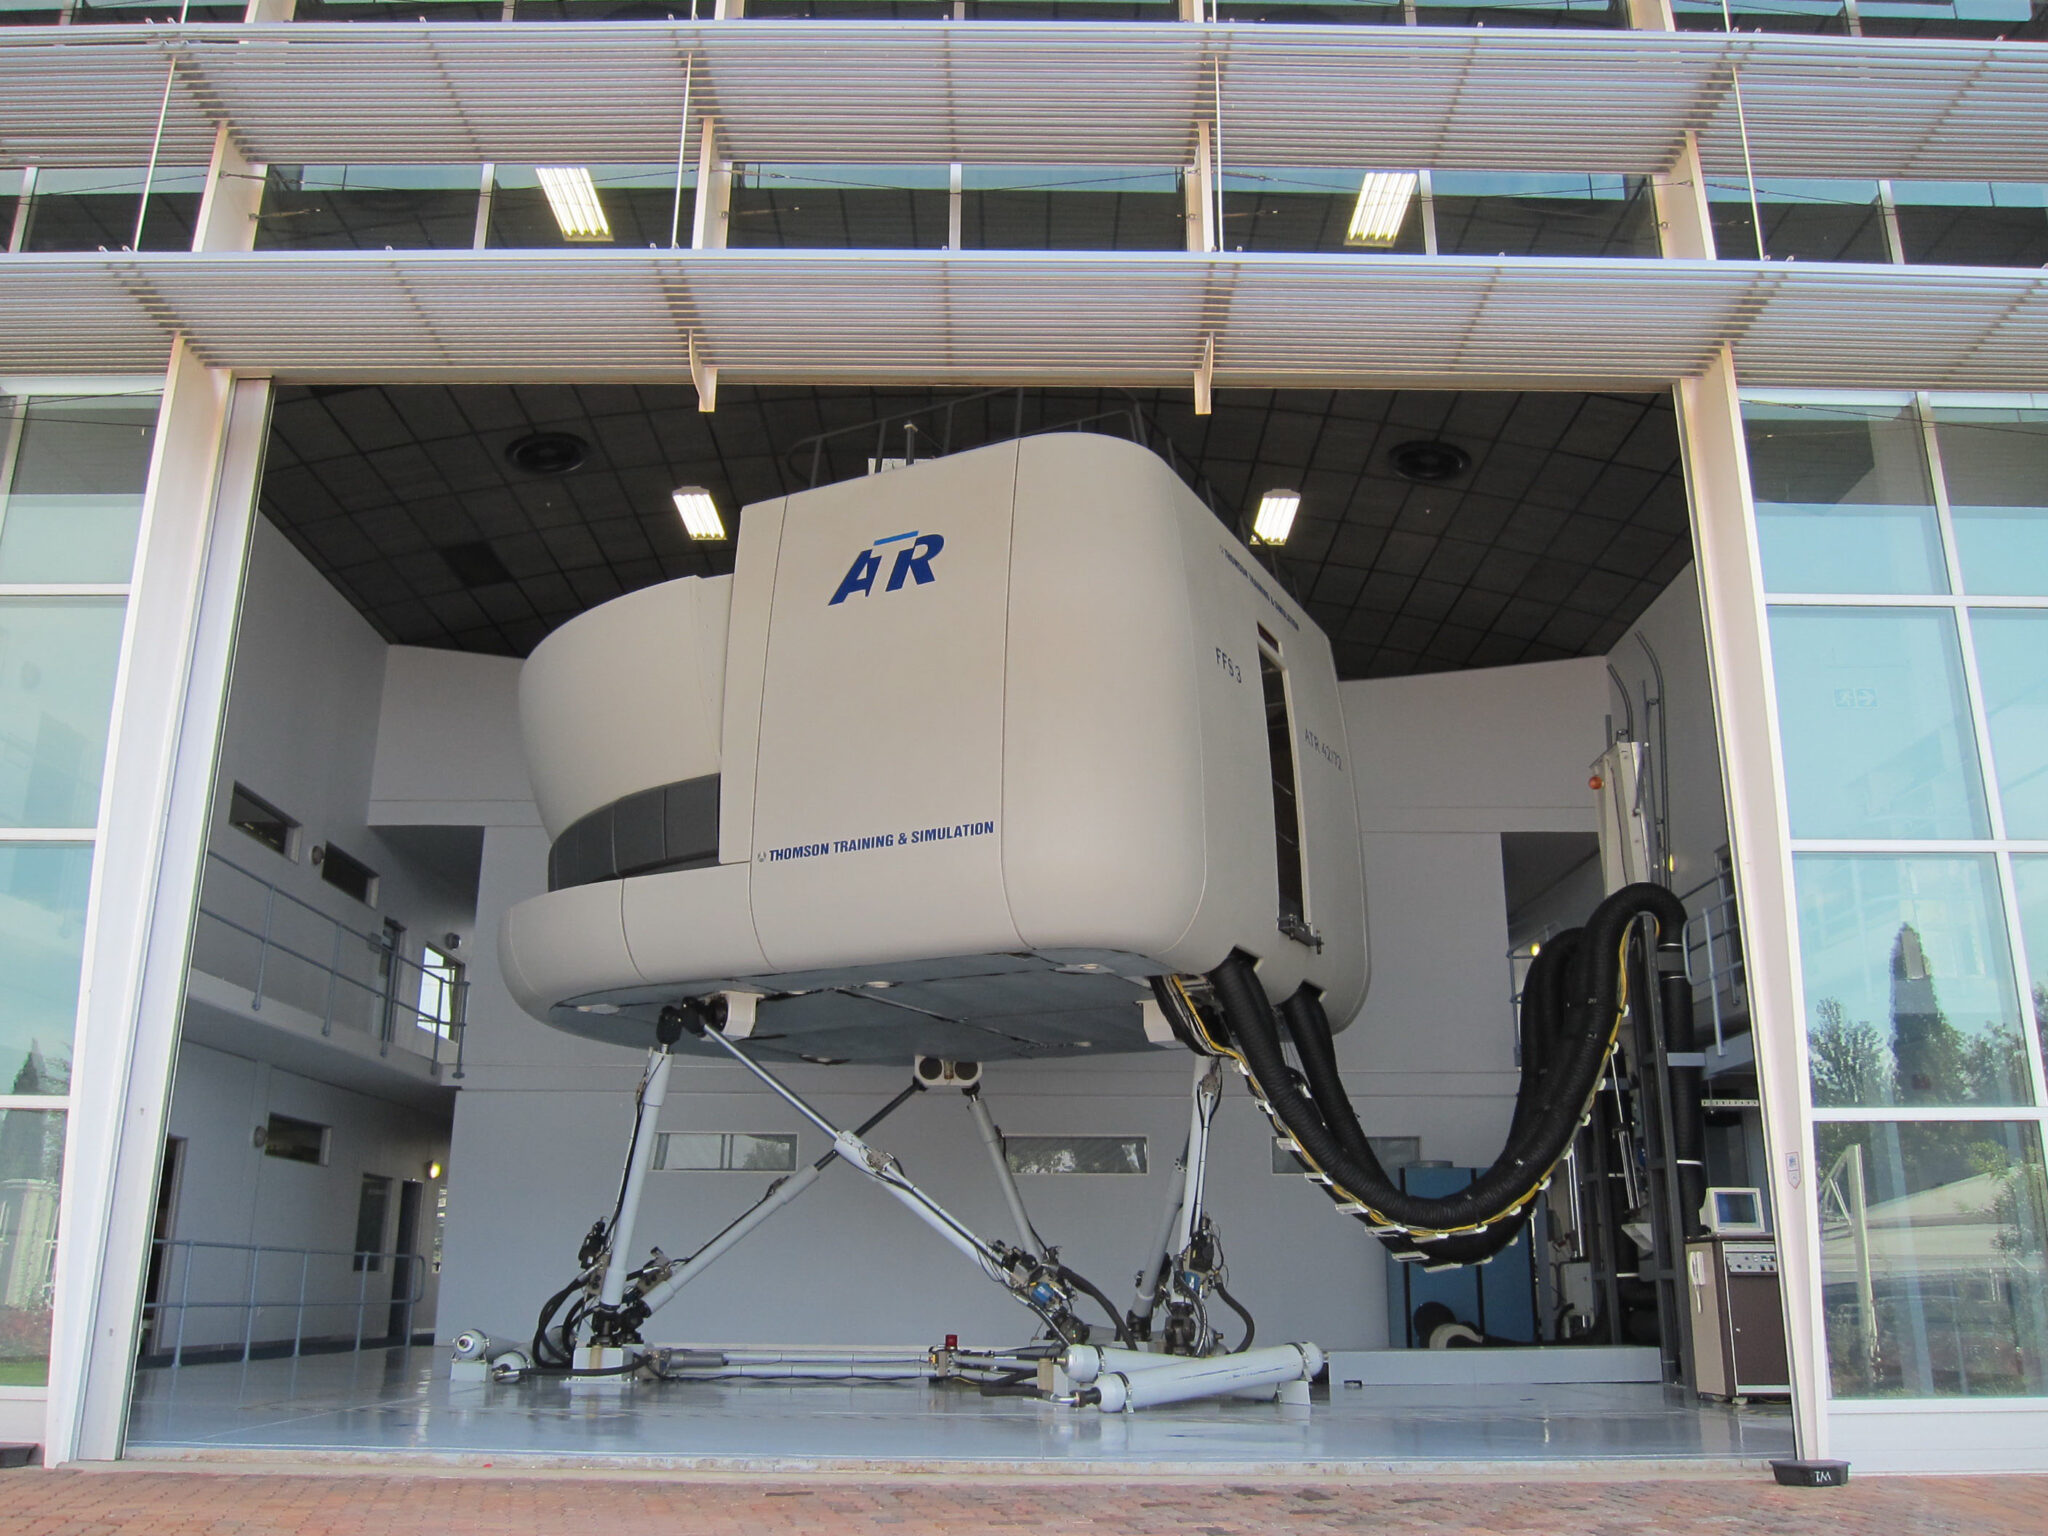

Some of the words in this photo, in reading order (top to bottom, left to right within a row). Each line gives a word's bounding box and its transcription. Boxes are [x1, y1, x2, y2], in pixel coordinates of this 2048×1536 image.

[828, 530, 945, 606] ATR
[1215, 647, 1235, 677] FFS
[1235, 665, 1242, 684] 3
[769, 842, 830, 862] THOMSON
[833, 833, 894, 854] TRAINING
[898, 832, 908, 845] &
[911, 821, 994, 844] SIMULATION
